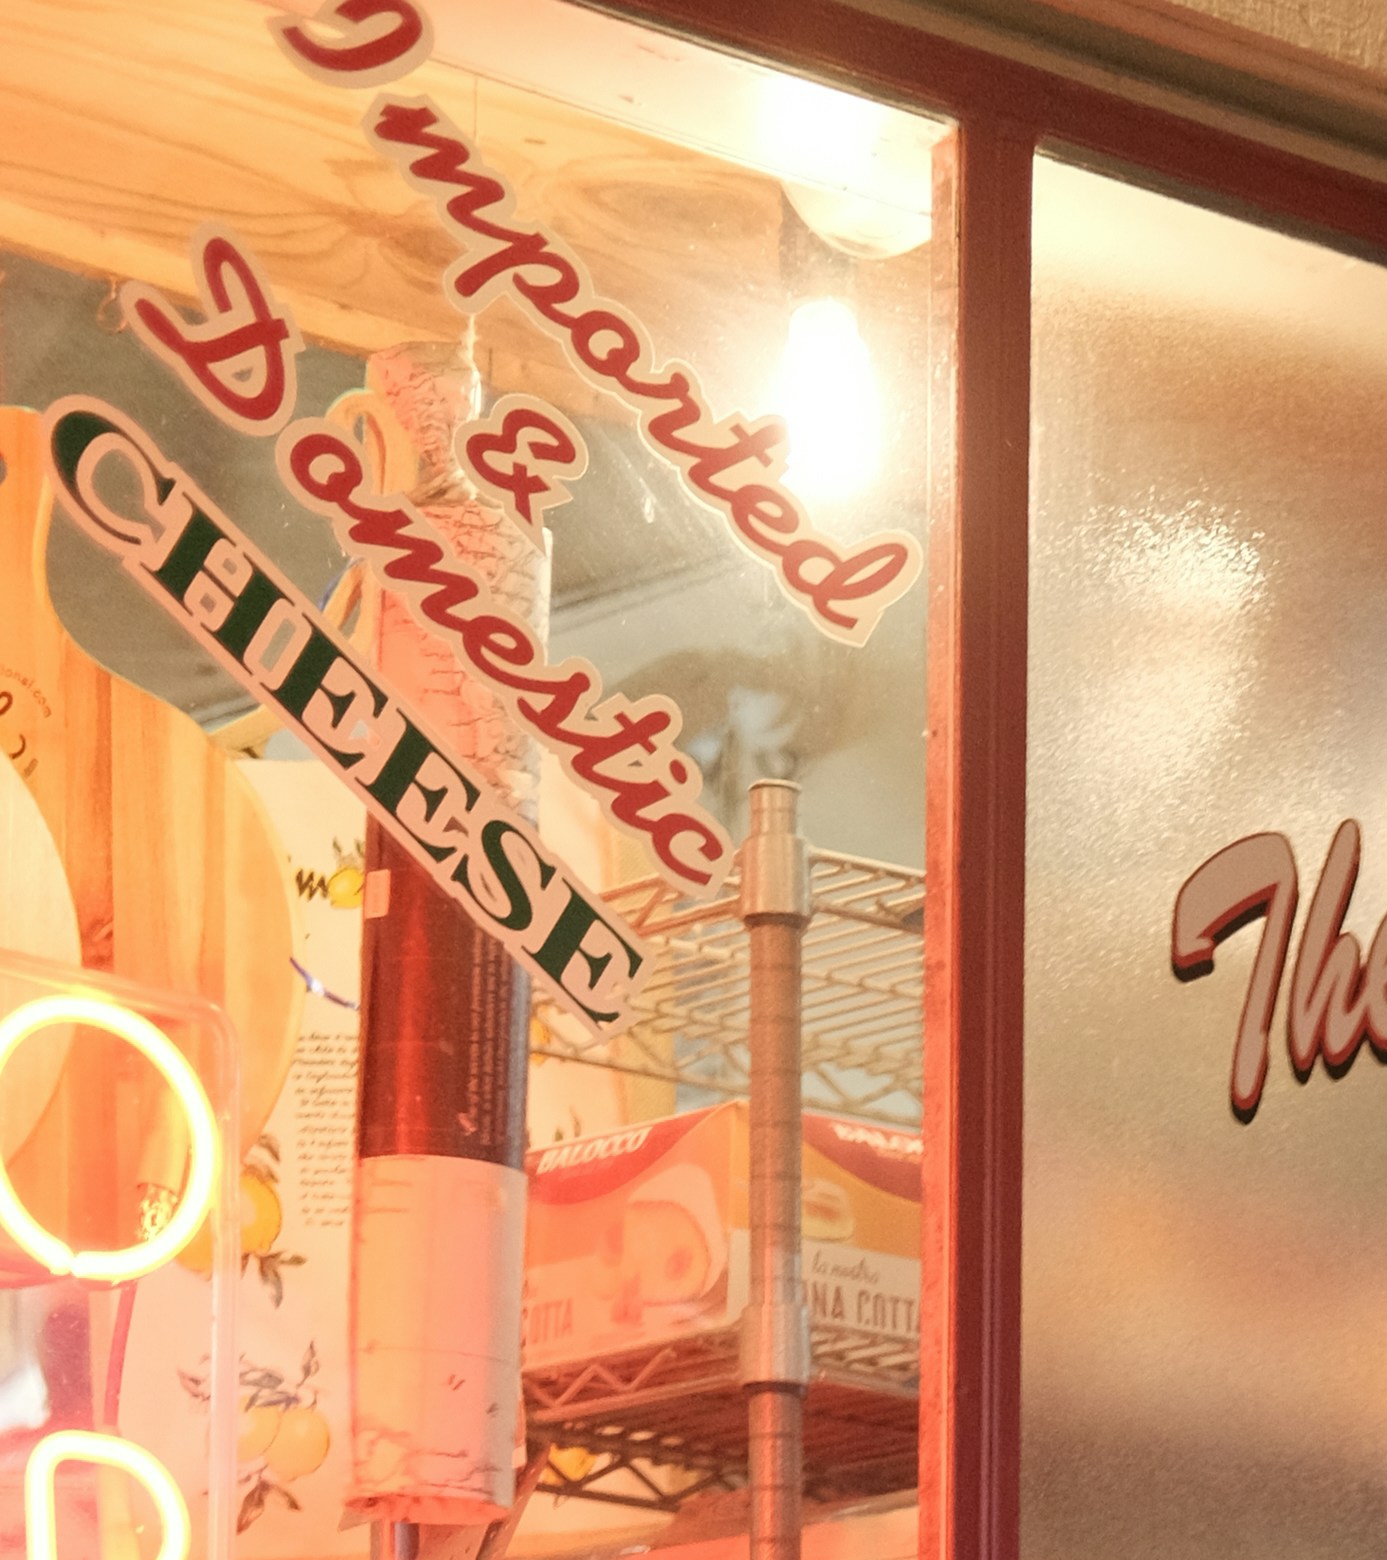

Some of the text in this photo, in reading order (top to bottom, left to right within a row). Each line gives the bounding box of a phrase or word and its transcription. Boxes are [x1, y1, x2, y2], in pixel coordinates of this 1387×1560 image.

[283, 0, 909, 631] Imported
[465, 408, 576, 524] &
[50, 410, 644, 1024] CHEESE
[134, 237, 723, 887] Domestic
[535, 1126, 654, 1175] BALOCCO
[857, 1289, 920, 1334] COTT
